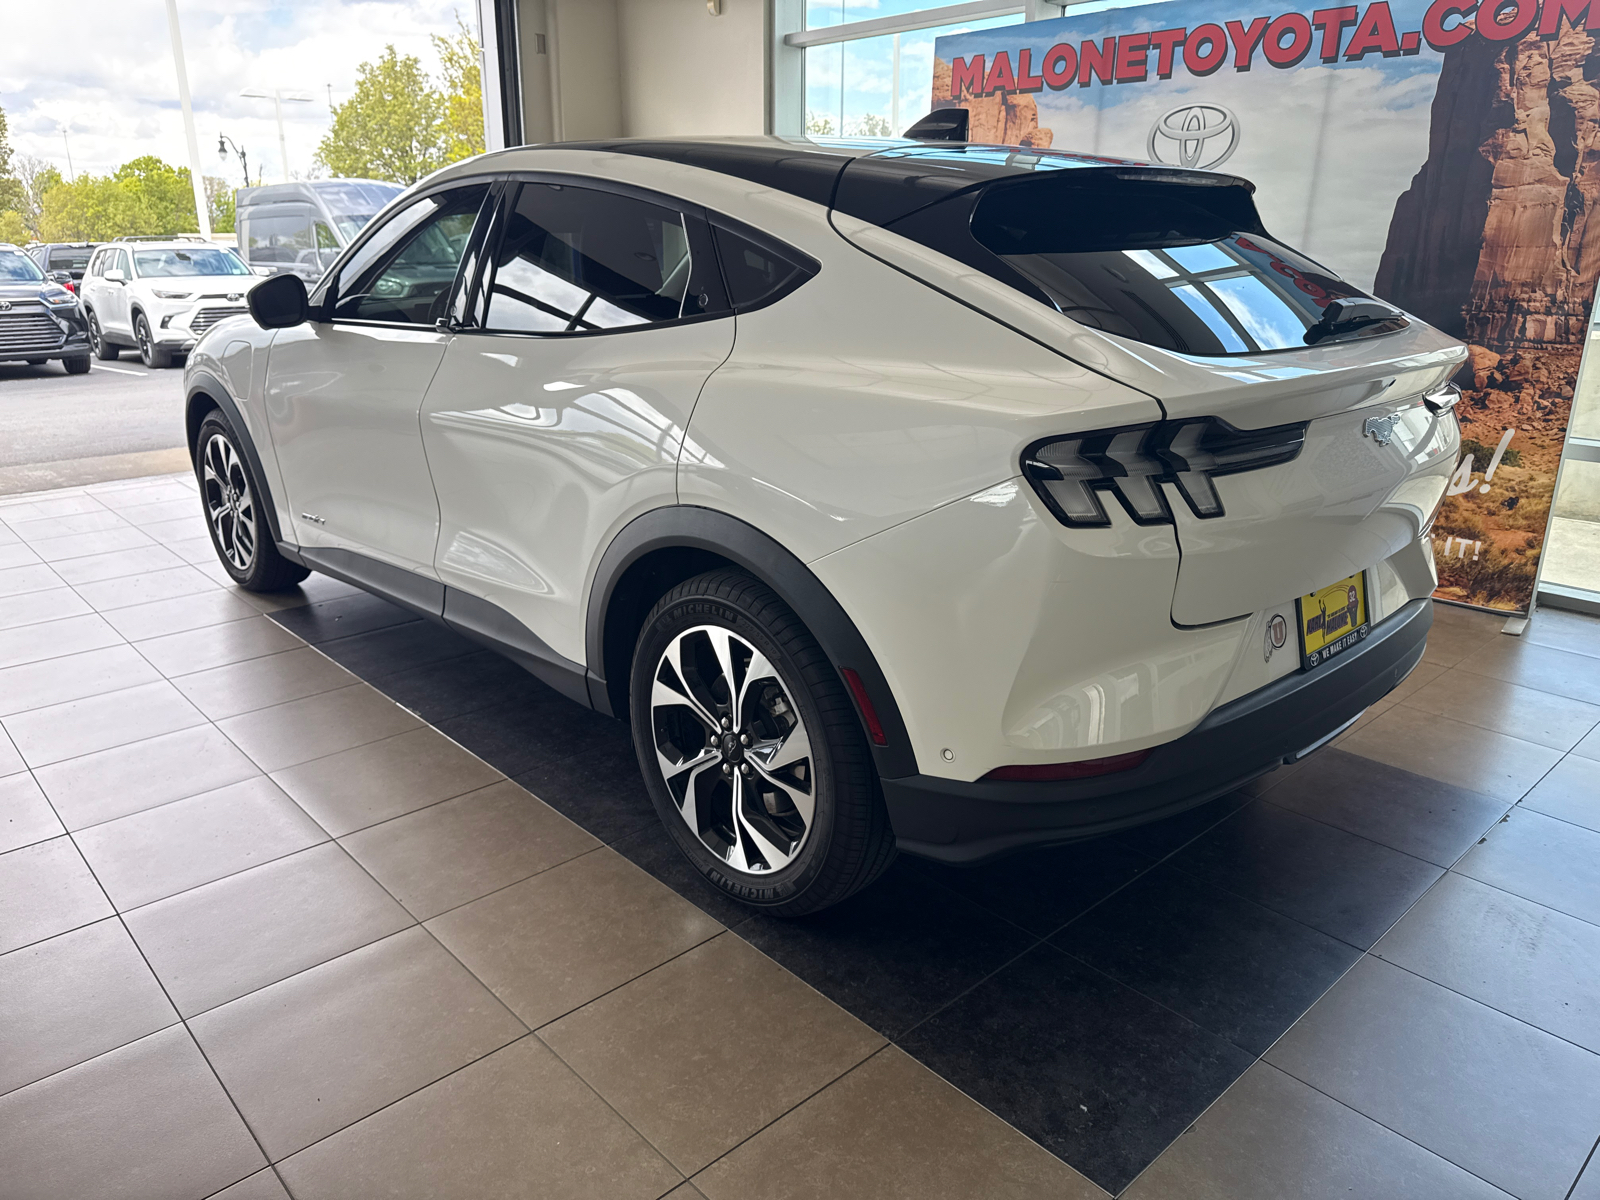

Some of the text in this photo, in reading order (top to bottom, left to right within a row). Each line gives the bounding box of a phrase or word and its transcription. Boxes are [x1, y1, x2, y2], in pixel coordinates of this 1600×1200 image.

[951, 0, 1600, 99] MALONETOYOTA.COM
[673, 603, 734, 621] MICHELIN
[1322, 632, 1358, 659] WE MAKE IT EASY
[709, 869, 774, 899] MICHELIN
